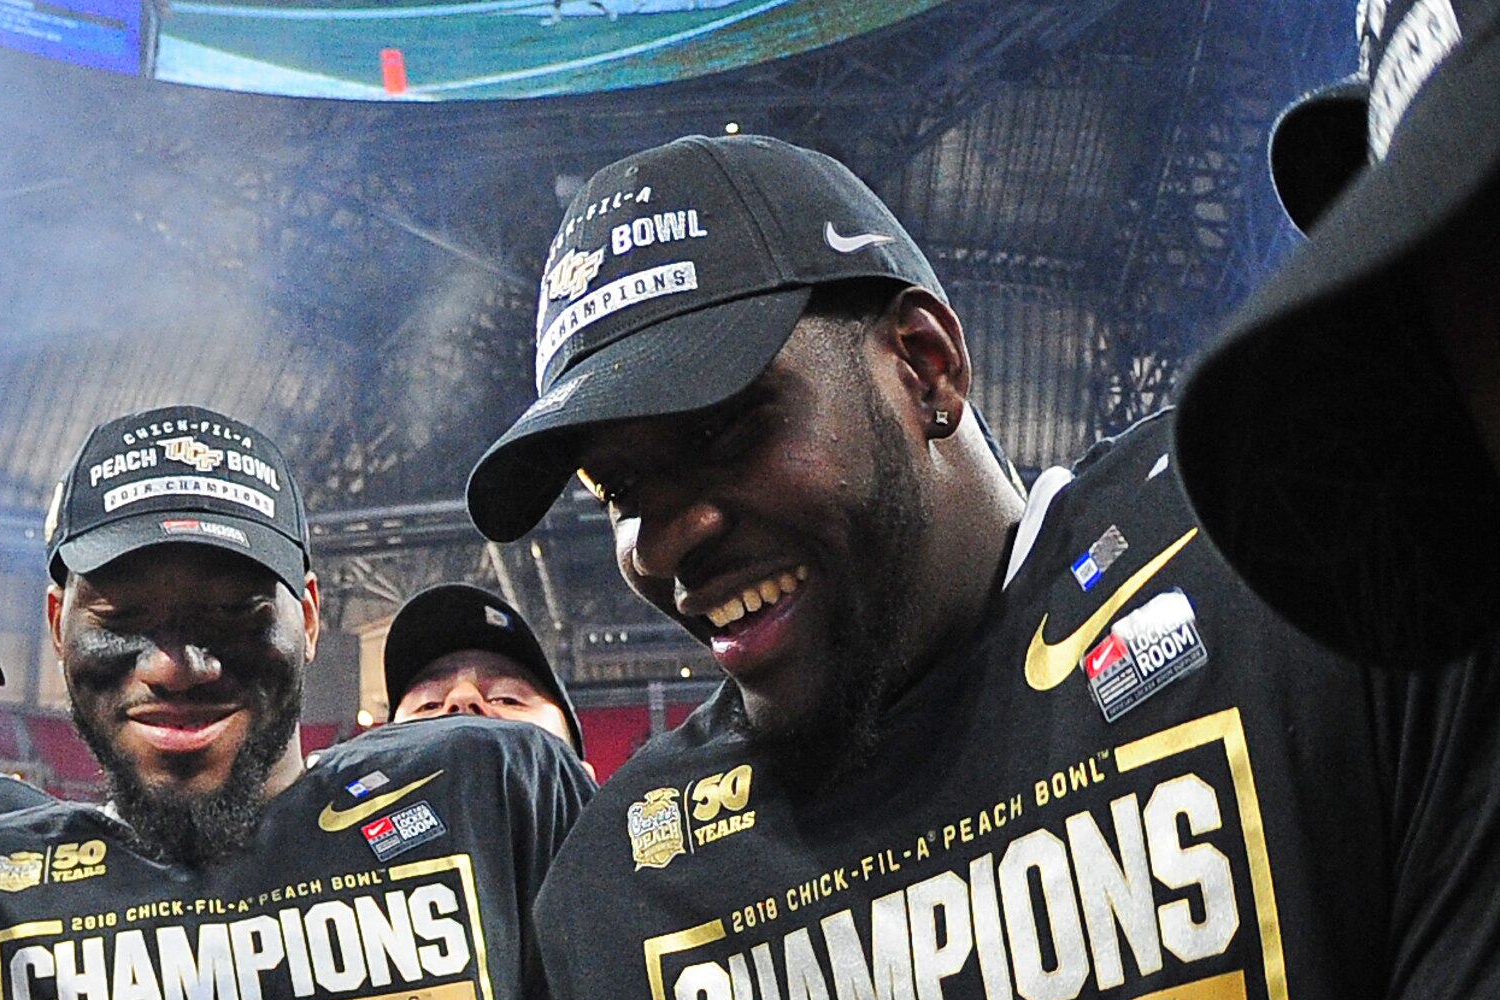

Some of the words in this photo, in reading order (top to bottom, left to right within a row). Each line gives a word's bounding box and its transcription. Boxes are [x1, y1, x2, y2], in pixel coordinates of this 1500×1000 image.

[611, 209, 708, 255] BOWL
[550, 268, 686, 347] CHAMPIONS
[122, 419, 252, 449] CHICK-FIL-A
[89, 447, 158, 488] PEACH
[156, 435, 225, 472] UCF
[226, 450, 281, 492] BOWL
[1136, 626, 1195, 677] ROOM
[691, 764, 753, 821] 50
[399, 818, 438, 841] ROOM
[693, 810, 756, 847] YEARS
[731, 896, 779, 933] 2018
[786, 836, 931, 912] CHICK-FIL-A
[943, 793, 1024, 850] PEACH
[1035, 758, 1108, 807] BOWL
[51, 839, 107, 870] 50
[51, 864, 107, 883] YEARS
[71, 911, 118, 931] 2018
[125, 898, 249, 922] CHICK-FIL-A
[258, 878, 323, 906] PEACH
[330, 869, 383, 892] BOWL
